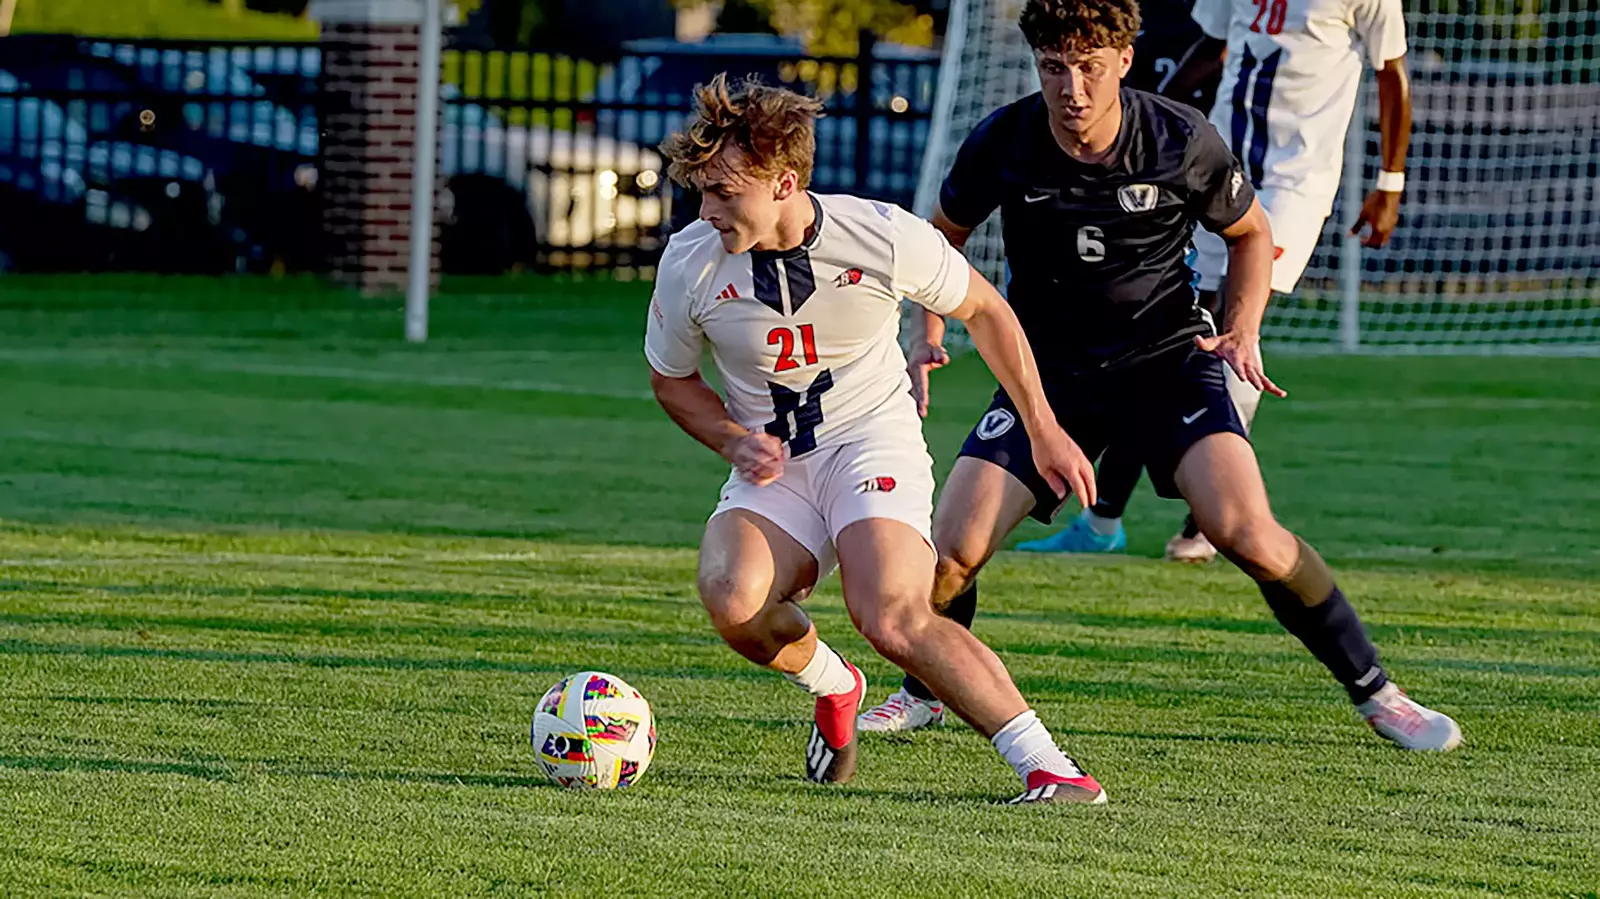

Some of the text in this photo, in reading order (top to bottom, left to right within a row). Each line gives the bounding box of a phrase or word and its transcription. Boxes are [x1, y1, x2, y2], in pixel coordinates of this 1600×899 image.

[1249, 0, 1287, 34] 20
[1077, 225, 1105, 262] 6
[767, 323, 819, 373] 21
